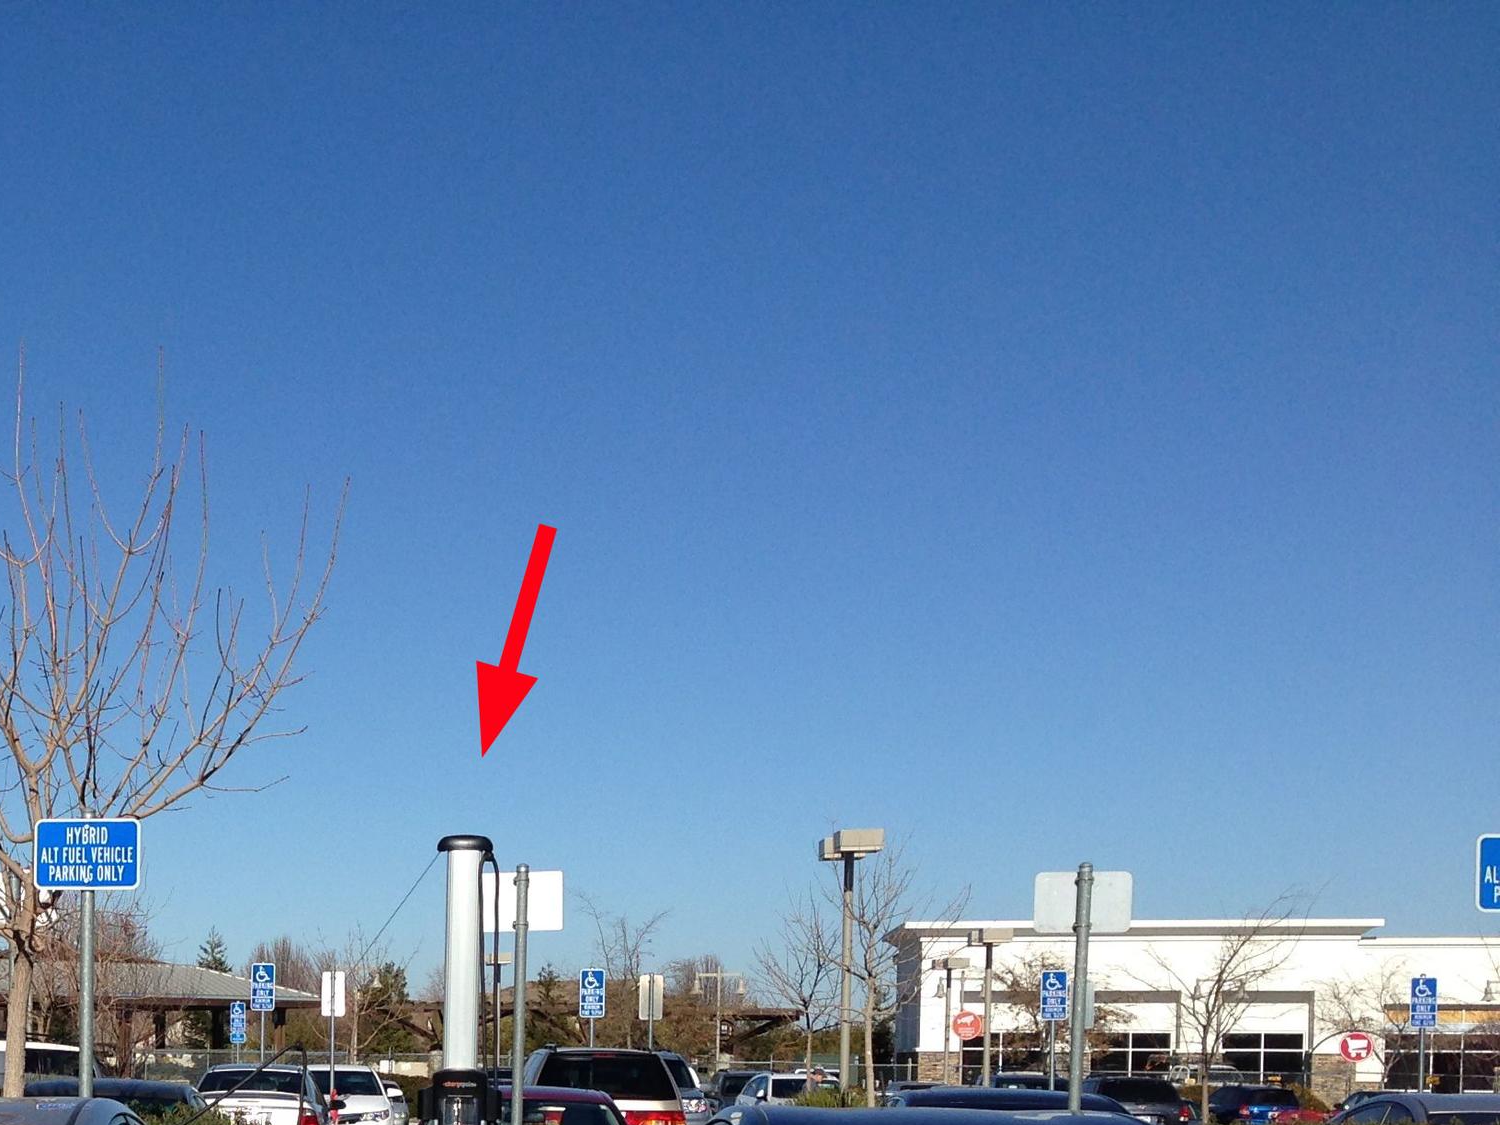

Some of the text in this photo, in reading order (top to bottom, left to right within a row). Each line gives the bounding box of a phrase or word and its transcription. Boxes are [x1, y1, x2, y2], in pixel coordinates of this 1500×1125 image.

[65, 826, 108, 845] HYBRID
[40, 847, 134, 864] ALT FUEL VEHICLE
[48, 864, 125, 883] PARKING ONLY
[1416, 1004, 1431, 1012] ONLY
